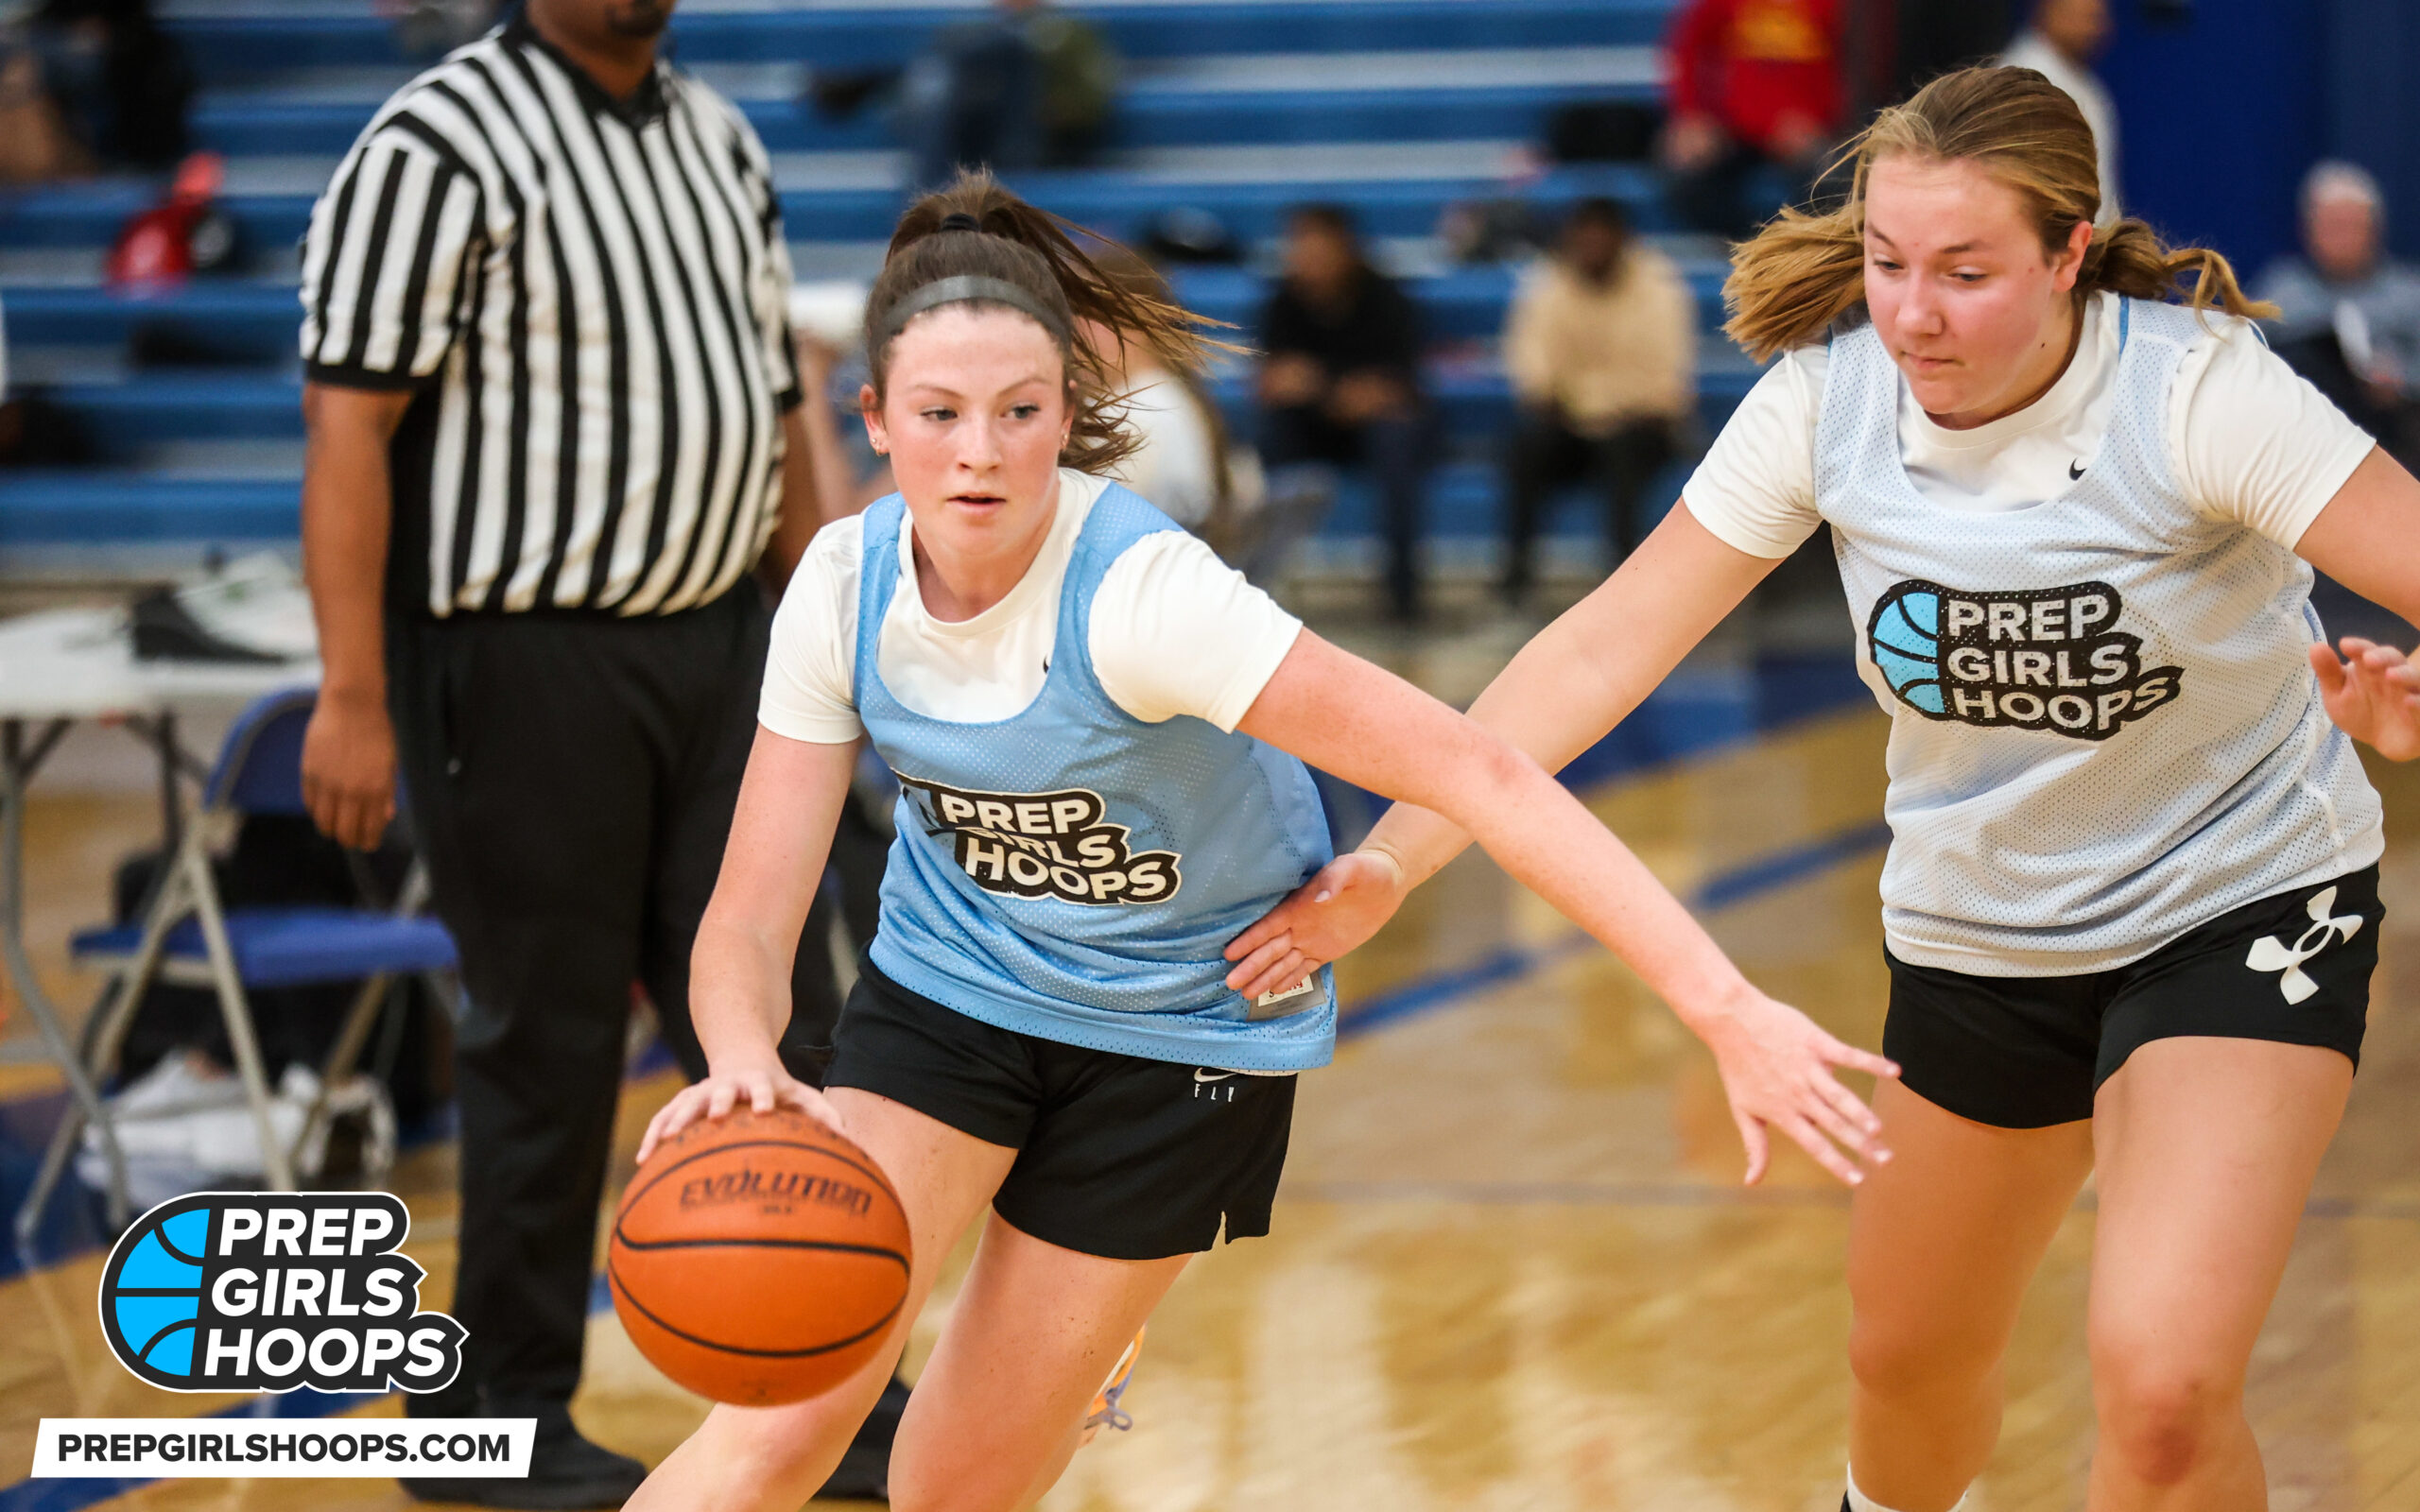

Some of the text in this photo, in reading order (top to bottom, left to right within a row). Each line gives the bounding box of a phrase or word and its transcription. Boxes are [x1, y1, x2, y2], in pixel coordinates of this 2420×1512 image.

[1947, 593, 2110, 642] PREP
[1946, 644, 2129, 687] GIRLS
[1952, 677, 2171, 731] HOOPS
[940, 793, 1091, 834] PREP
[964, 836, 1167, 900] HOOPS
